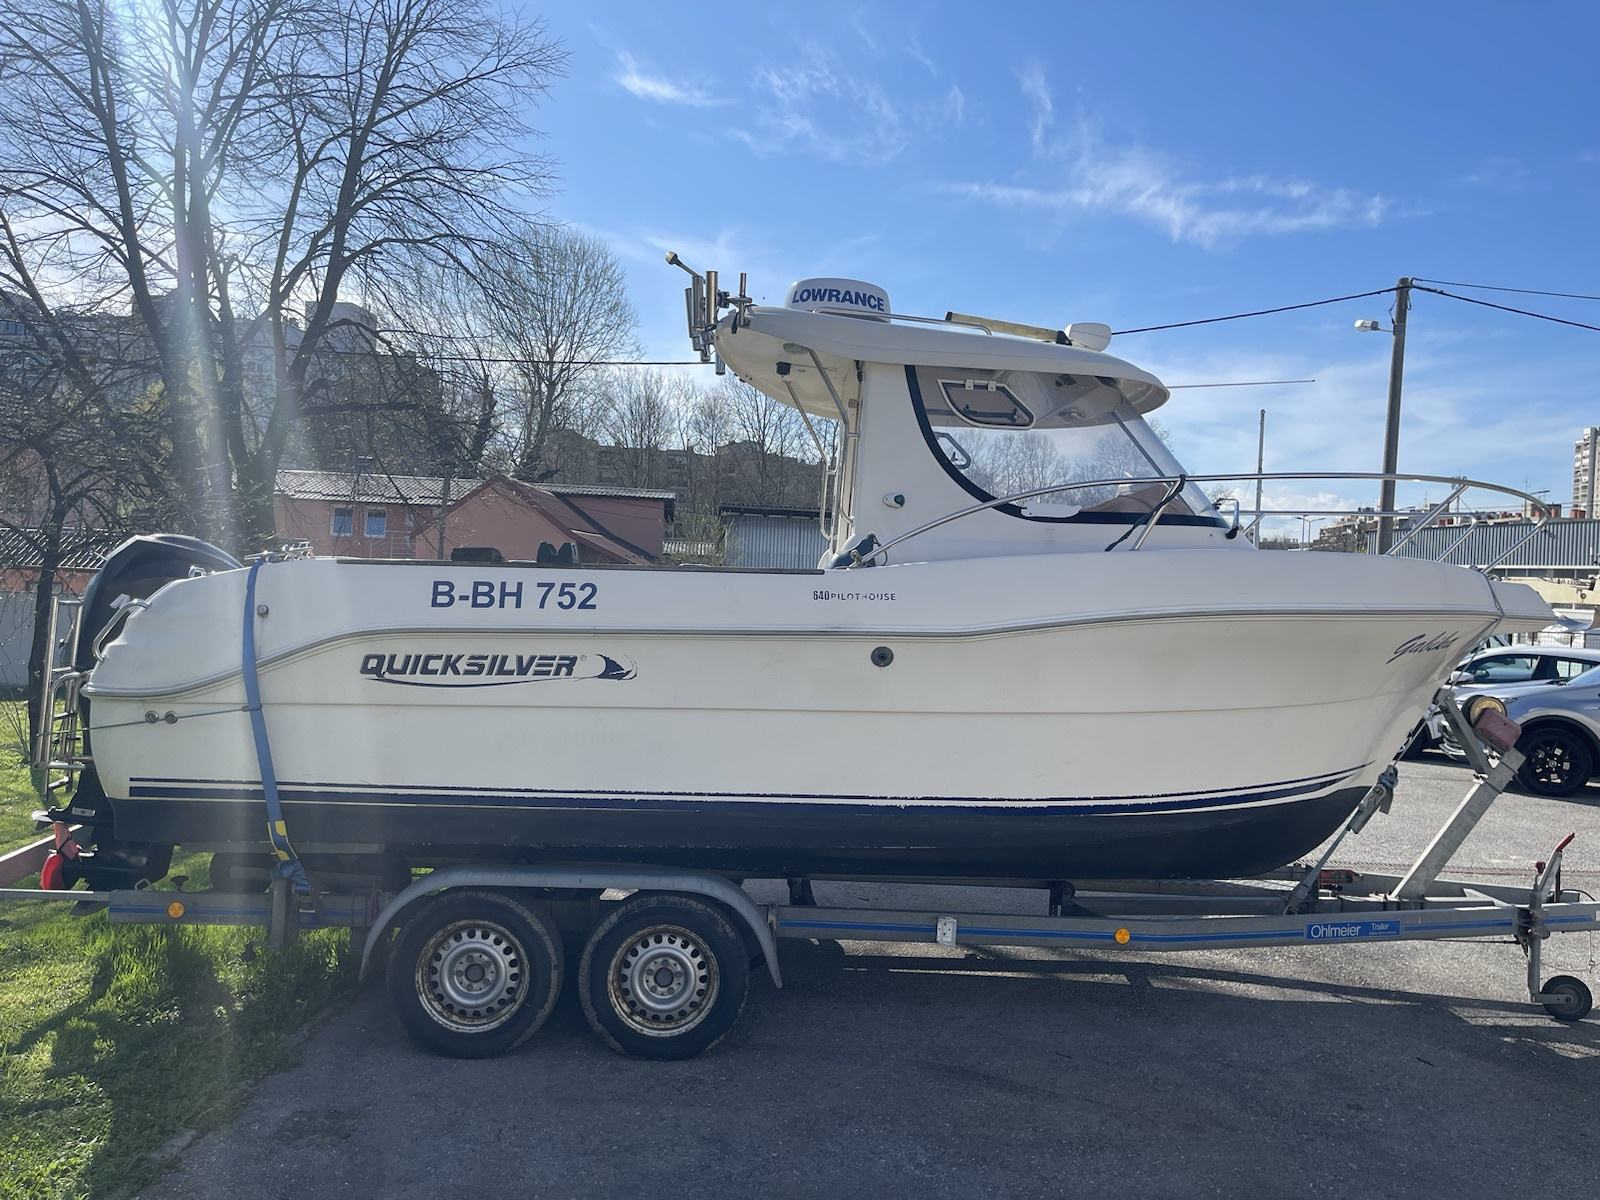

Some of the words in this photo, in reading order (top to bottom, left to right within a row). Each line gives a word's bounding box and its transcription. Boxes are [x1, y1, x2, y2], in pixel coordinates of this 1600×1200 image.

[791, 288, 885, 312] LOWRANCE
[430, 580, 523, 609] B-BH
[536, 582, 598, 610] 752
[813, 590, 830, 601] 640
[359, 653, 578, 679] QUICKSILVER
[1310, 923, 1362, 939] Ohlmeier
